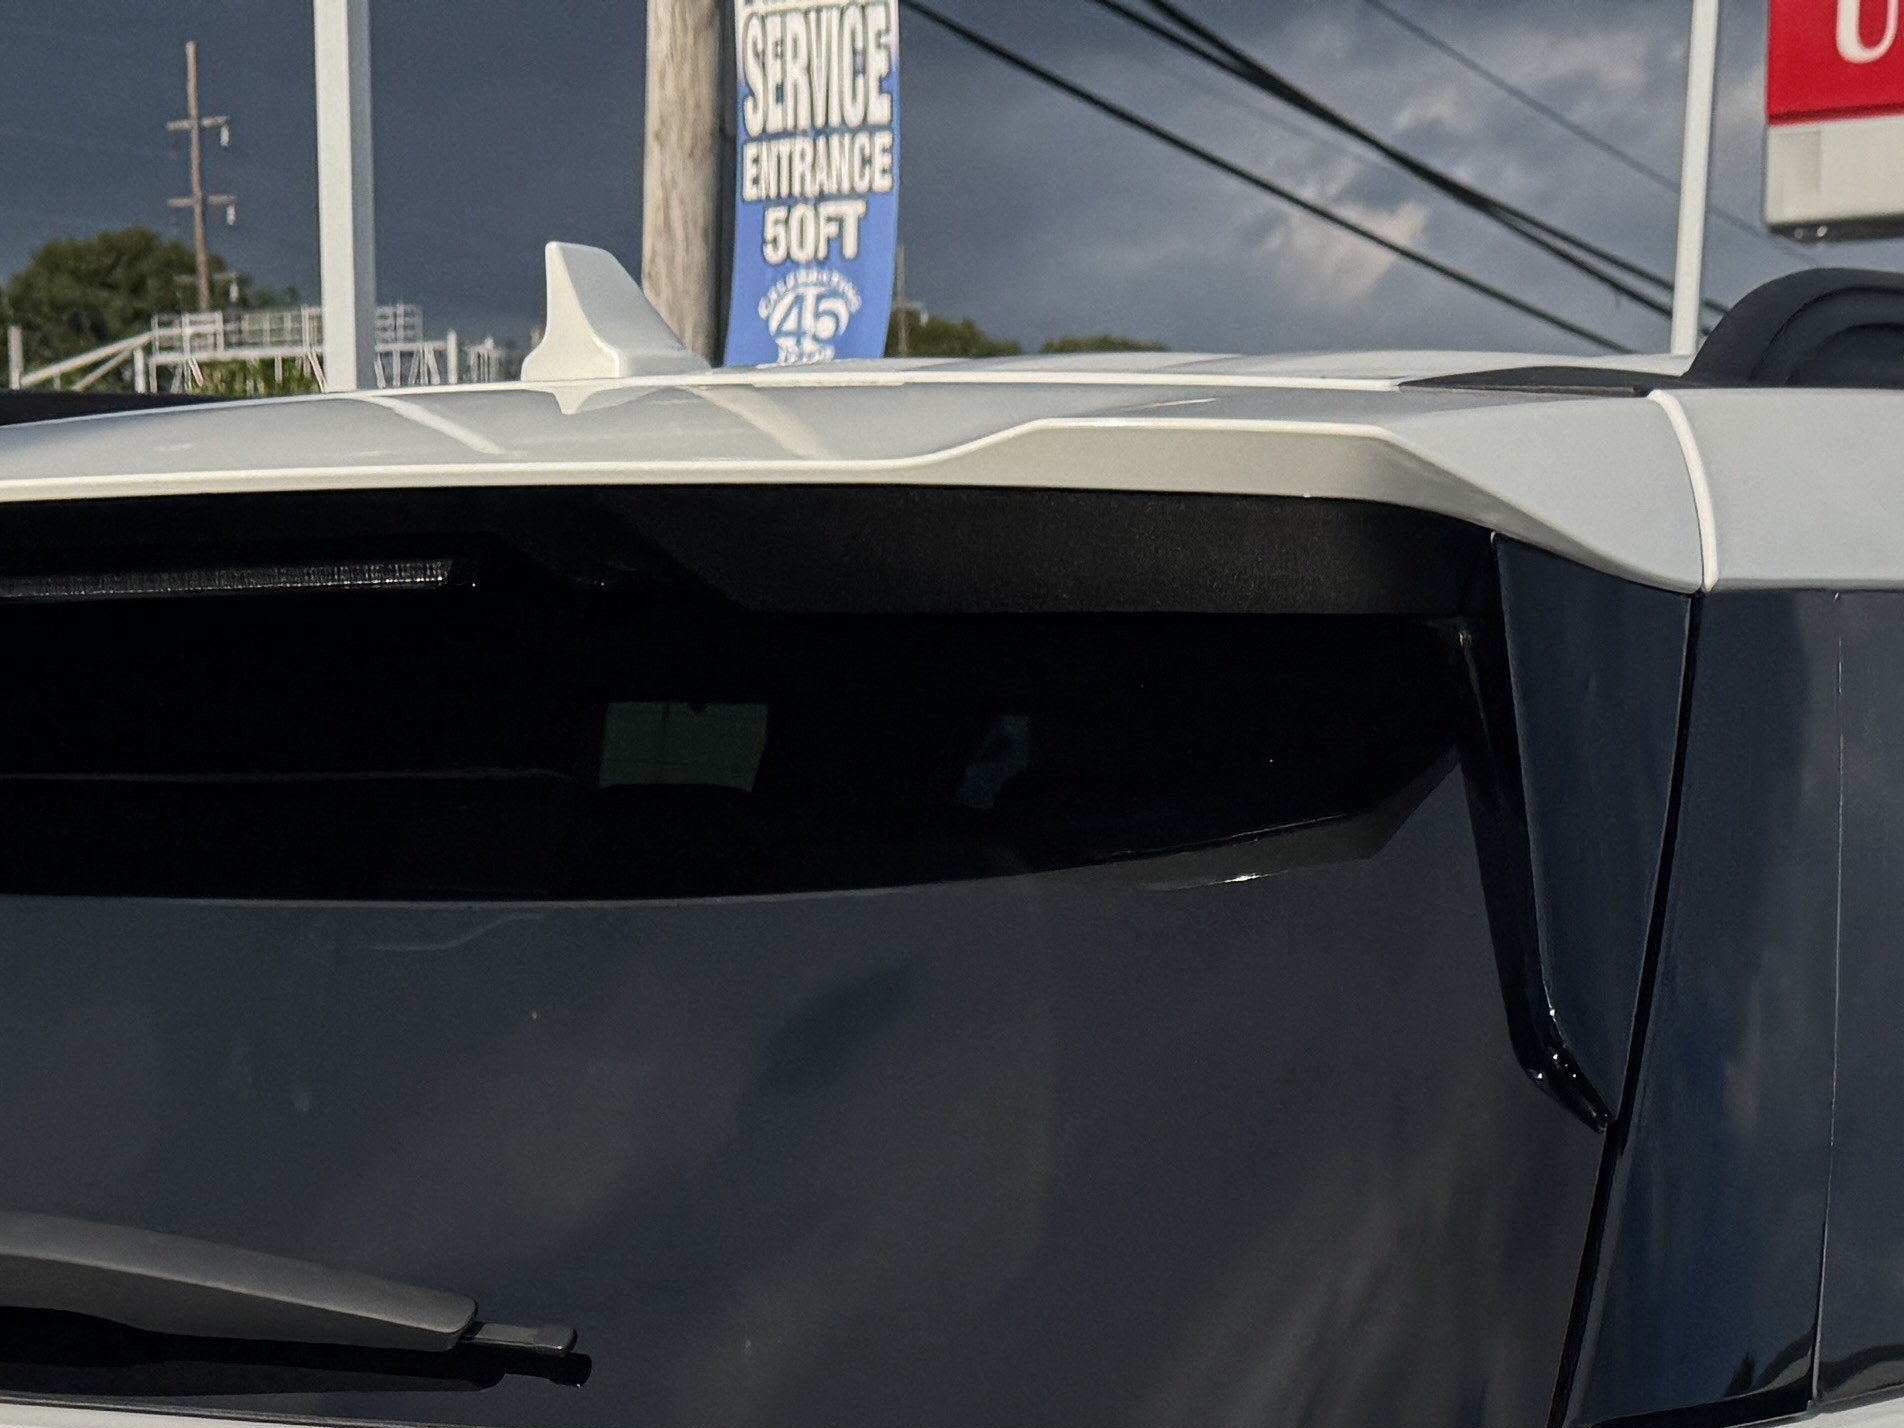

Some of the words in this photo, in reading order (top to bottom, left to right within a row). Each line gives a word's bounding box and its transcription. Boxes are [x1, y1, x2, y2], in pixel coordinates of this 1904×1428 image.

[741, 5, 894, 138] SERVICE
[741, 131, 894, 202] ENTRANCE
[762, 200, 868, 266] 50FT
